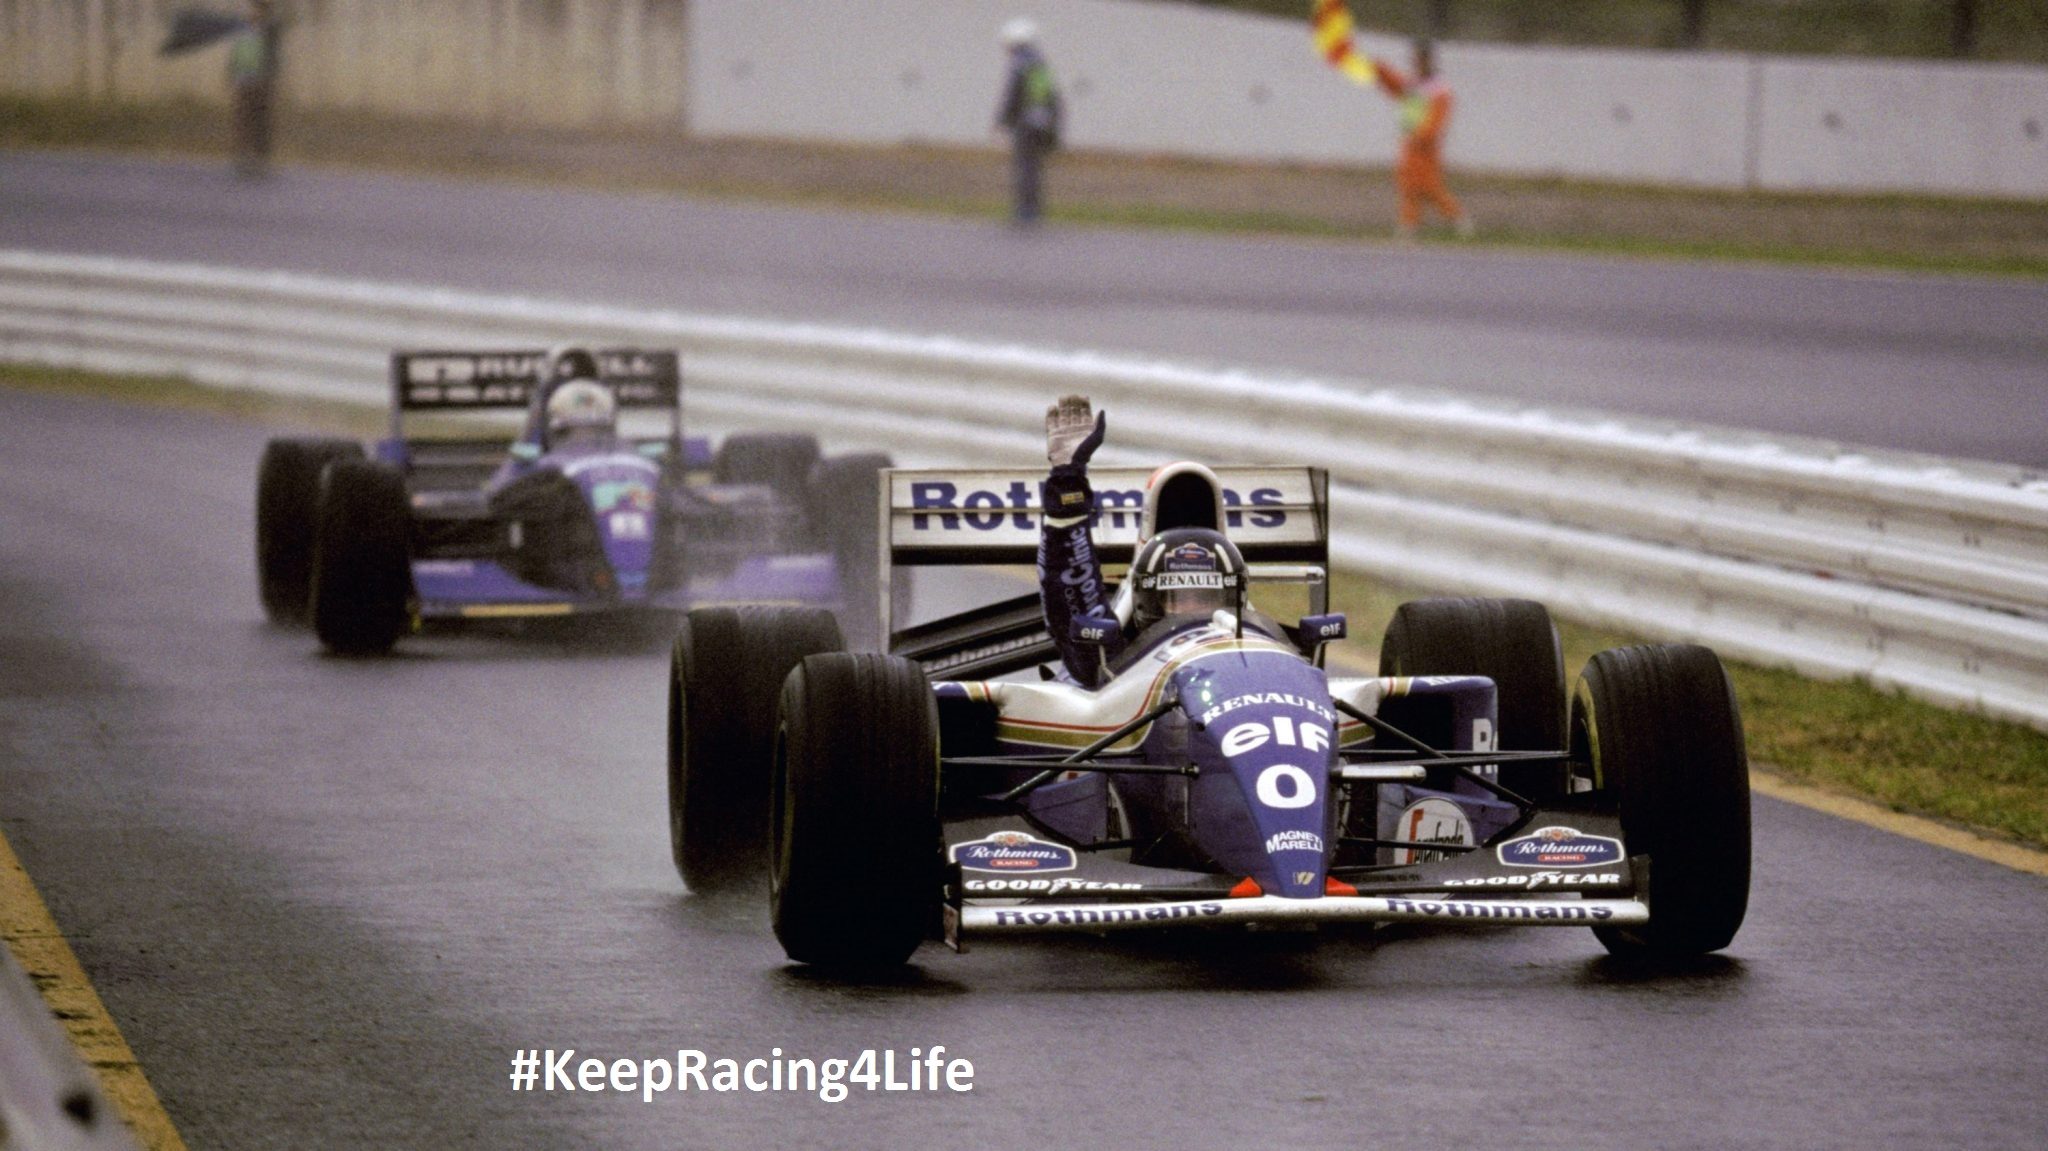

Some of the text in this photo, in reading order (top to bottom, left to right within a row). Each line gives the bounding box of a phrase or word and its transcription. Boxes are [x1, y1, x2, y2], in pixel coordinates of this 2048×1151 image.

[1160, 574, 1220, 587] RENAULT
[1081, 627, 1105, 640] elf
[1320, 623, 1341, 636] elf
[1202, 692, 1336, 727] RENAULT
[1221, 716, 1330, 758] elf
[966, 845, 1063, 860] Rothmans
[1514, 841, 1609, 855] Rothmans
[996, 901, 1223, 926] Rothmans
[1387, 898, 1613, 920] Rothmans
